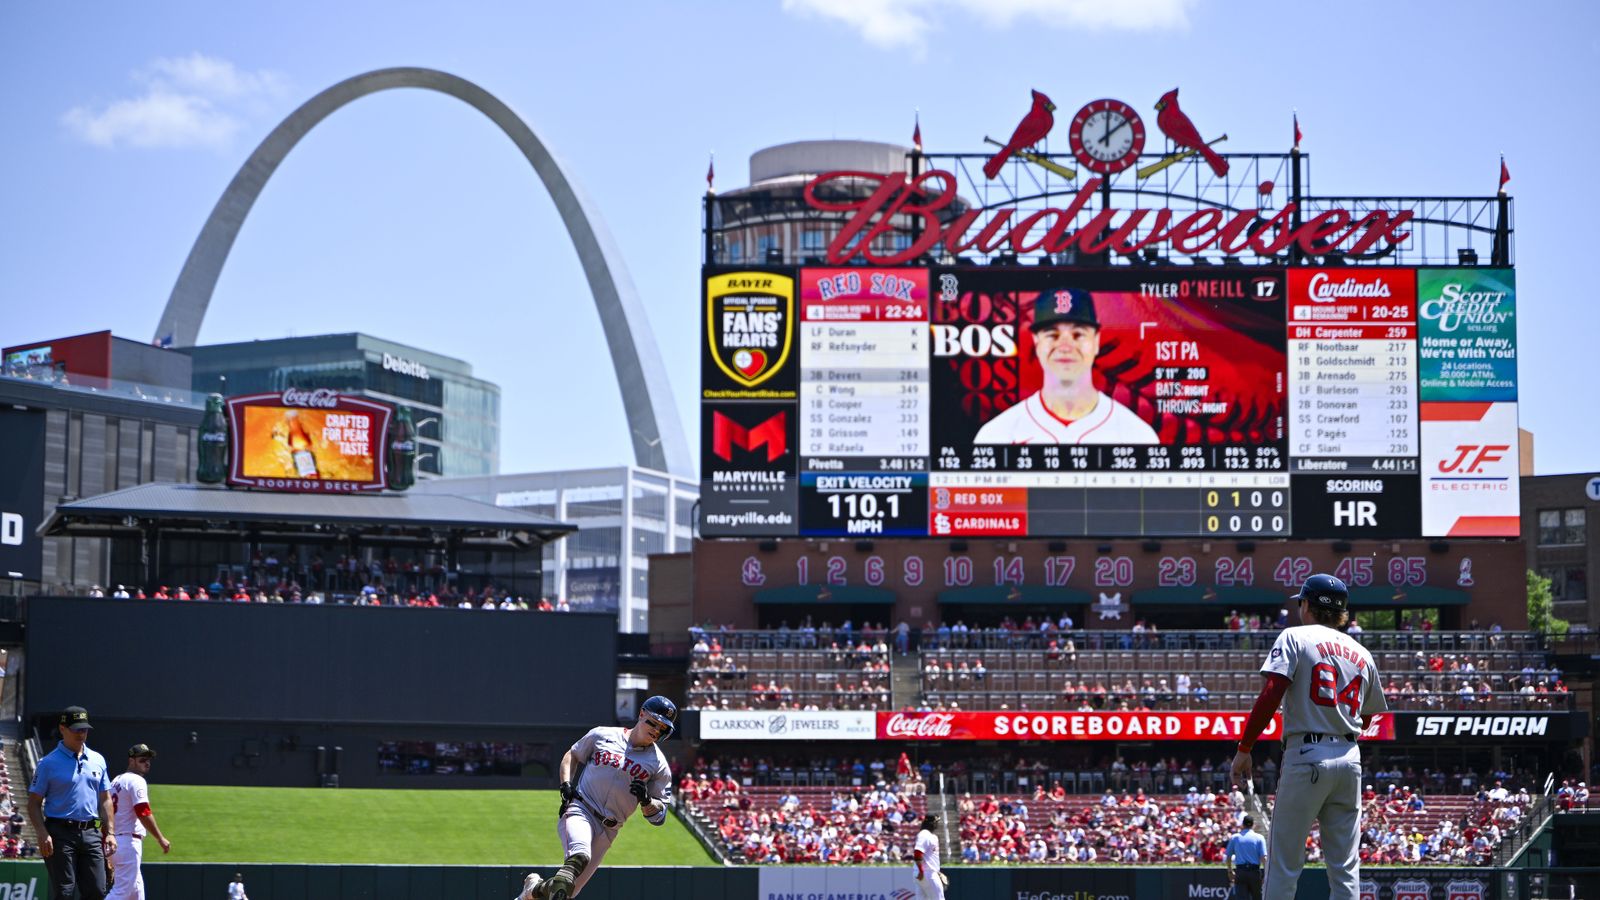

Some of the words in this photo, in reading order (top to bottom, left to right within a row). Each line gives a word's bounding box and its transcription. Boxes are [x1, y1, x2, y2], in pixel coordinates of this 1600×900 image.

[804, 170, 1414, 266] Budweiser
[727, 279, 772, 288] BAYER
[818, 273, 860, 300] RED
[870, 272, 916, 302] SOX
[1140, 283, 1178, 298] TYLER
[1181, 279, 1245, 298] O'NEILL
[1256, 282, 1275, 297] 17
[1308, 272, 1391, 302] Cardinals
[1440, 283, 1506, 304] SCOTT
[885, 305, 922, 318] 22-24
[1371, 305, 1409, 318] 20-25
[1420, 299, 1499, 320] CREDIT
[722, 313, 782, 333] FANS'
[1467, 325, 1498, 333] scu.org
[828, 328, 856, 337] Duran
[911, 328, 918, 336] K
[1295, 327, 1311, 338] DH
[1315, 327, 1363, 339] Carpenter
[1385, 327, 1407, 338] .259
[722, 333, 778, 348] HEARTS
[932, 324, 1017, 357] BOS
[1422, 337, 1458, 347] Home
[1460, 339, 1473, 347] or
[1475, 337, 1512, 349] Away,
[828, 342, 877, 353] Refsnyder
[911, 343, 918, 351] K
[1155, 341, 1179, 360] 1ST
[1181, 341, 1199, 360] PA
[1316, 343, 1359, 352] Nootbaar
[1385, 343, 1407, 352] .217
[1421, 348, 1455, 358] We're
[1457, 348, 1486, 358] With
[1488, 348, 1515, 358] You!
[1316, 357, 1375, 367] Goldschmidt
[1385, 357, 1407, 366] .213
[828, 371, 861, 381] Devers
[1316, 371, 1356, 381] Arenado
[1385, 372, 1408, 381] .275
[828, 385, 855, 397] Wong
[897, 385, 918, 394] .349
[1316, 385, 1359, 395] Burleson
[1386, 386, 1408, 395] .293
[282, 388, 338, 407] Coca-Cola
[828, 400, 862, 411] Cooper
[897, 400, 918, 409] .227
[1317, 400, 1358, 410] Donovan
[325, 414, 370, 429] CRAFTED
[828, 414, 872, 424] Gonzalez
[897, 414, 919, 424] .333
[1317, 414, 1360, 424] Crawford
[1386, 415, 1408, 424] .107
[322, 427, 341, 442] FOR
[343, 428, 369, 443] PEAK
[713, 410, 786, 463] M
[828, 428, 868, 438] Grissom
[897, 428, 919, 438] .149
[1386, 429, 1408, 439] .125
[340, 442, 369, 456] TASTE
[828, 443, 864, 452] Rafaela
[897, 443, 919, 452] .197
[940, 447, 956, 456] PA
[972, 447, 994, 456] AVG
[1020, 447, 1029, 456] H
[1044, 447, 1059, 456] HR
[1070, 447, 1088, 456] RBI
[1112, 447, 1134, 456] OBP
[1147, 447, 1167, 456] SLG
[1181, 447, 1203, 456] OPS
[1225, 447, 1247, 456] BB%
[1256, 447, 1279, 456] SO%
[1317, 443, 1341, 453] Siani
[1386, 444, 1408, 453] .230
[808, 459, 844, 470] Pivetta
[880, 459, 903, 470] 3.48
[909, 459, 924, 470] 1-2
[938, 457, 961, 469] 152
[970, 457, 996, 469] .254
[1017, 457, 1032, 469] 33
[1045, 457, 1060, 469] 10
[1072, 457, 1087, 469] 16
[1110, 457, 1137, 469] .362
[1145, 457, 1171, 469] .531
[1179, 457, 1205, 469] .893
[1224, 457, 1249, 469] 13.2
[1254, 457, 1282, 469] 31.6
[1297, 459, 1348, 470] Liberatore
[1371, 460, 1395, 471] 4.44
[1402, 460, 1416, 471] 1-1
[713, 471, 786, 483] MARYVILLE
[816, 476, 846, 489] EXIT
[848, 476, 912, 489] VELOCITY
[257, 479, 320, 490] ROOFTOP
[326, 482, 359, 491] DECK
[713, 484, 785, 492] UNIVERSITY
[1326, 479, 1383, 492] SCORING
[1431, 483, 1509, 491] ELECTRIC
[827, 493, 900, 518] 110.1
[954, 493, 977, 505] RED
[980, 493, 1003, 505] SOX
[1207, 491, 1219, 507] 0
[1231, 491, 1240, 507] 1
[1250, 491, 1263, 507] 0
[1271, 491, 1283, 507] 0
[706, 512, 792, 527] maryville.edu
[1334, 501, 1377, 527] HR
[848, 520, 883, 534] MPH
[954, 518, 1020, 529] CARDINALS
[1207, 516, 1219, 532] 0
[1229, 516, 1241, 532] 0
[1251, 516, 1263, 532] 0
[1271, 516, 1284, 532] 0
[797, 556, 808, 586] 1
[827, 556, 847, 586] 2
[864, 556, 885, 586] 6
[903, 556, 924, 586] 9
[944, 556, 973, 586] 10
[994, 556, 1025, 586] 14
[1044, 556, 1076, 586] 17
[1095, 556, 1134, 587] 20
[1158, 556, 1197, 587] 23
[1215, 556, 1254, 587] 24
[1274, 556, 1313, 587] 42
[1334, 556, 1373, 587] 45
[1387, 556, 1427, 587] 85
[1315, 641, 1367, 671] HUDSON
[1309, 661, 1364, 718] 84
[709, 719, 764, 730] CLARKSON
[790, 719, 839, 730] JEWELERS
[886, 713, 955, 737] Coca-Cola
[994, 716, 1181, 735] SCOREBOARD
[1195, 716, 1277, 735] PATO
[1415, 717, 1453, 736] 1ST
[1454, 717, 1548, 736] PHORM
[592, 750, 650, 783] BOSTON
[1189, 884, 1231, 900] Mercy
[1397, 884, 1427, 893] PHILLIPS
[1450, 884, 1483, 893] PHILLIPS
